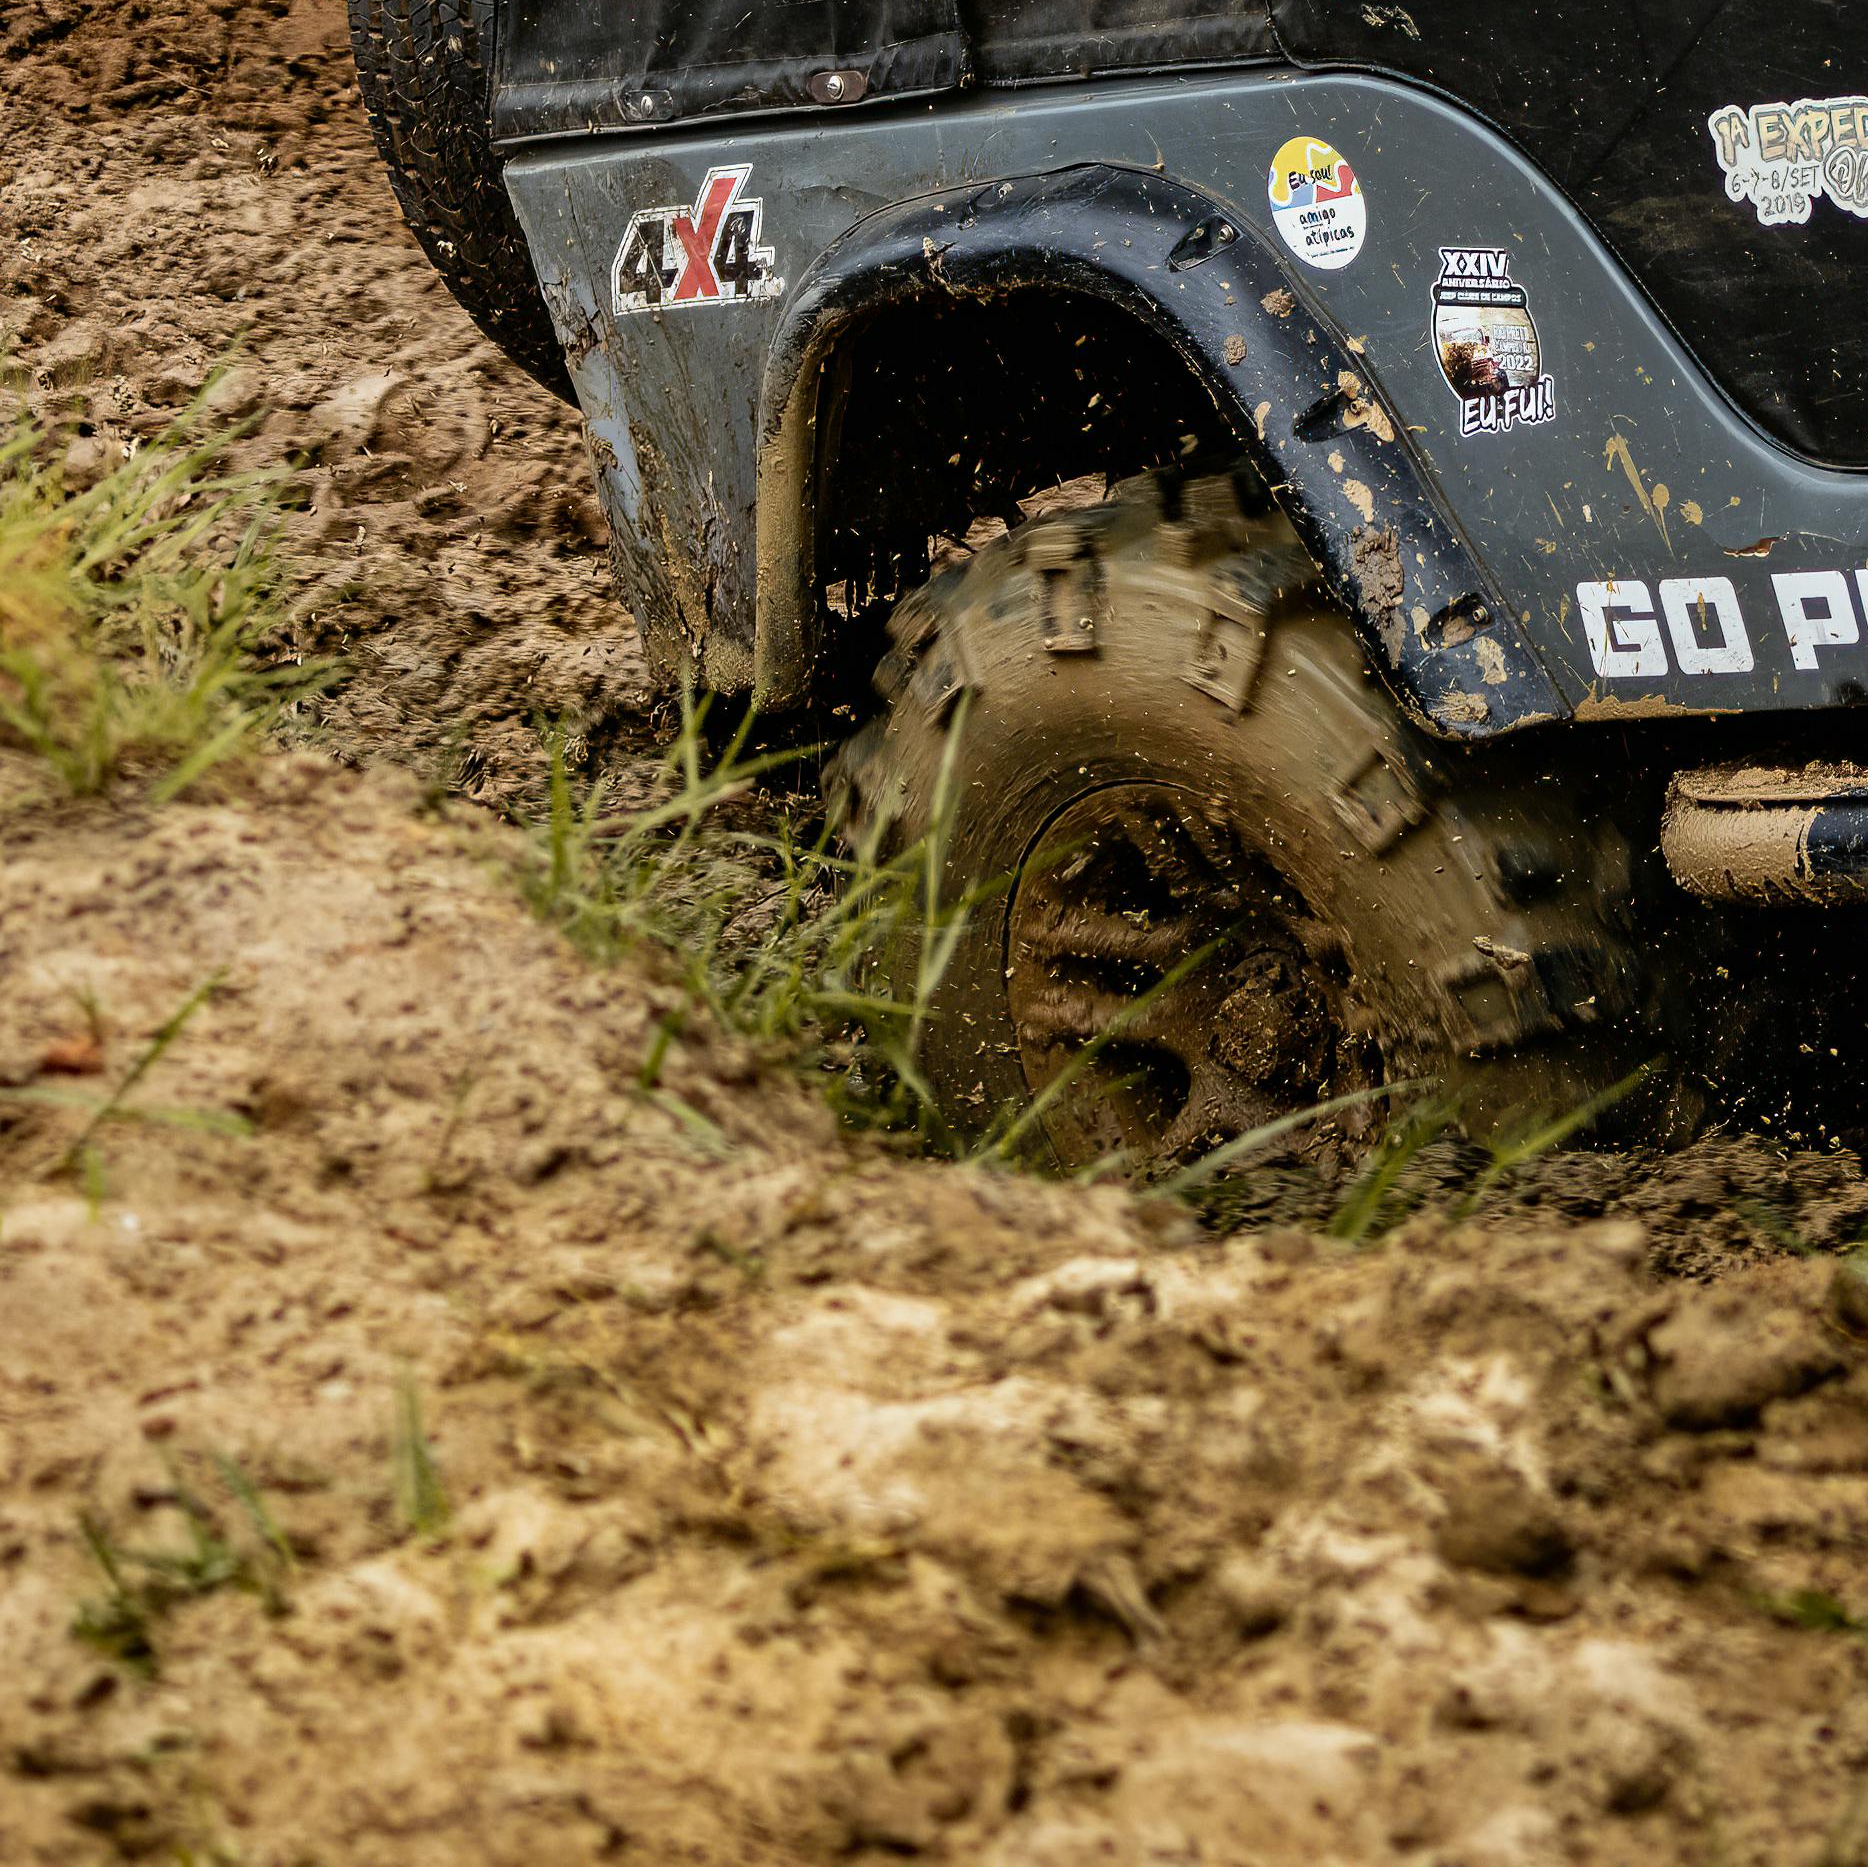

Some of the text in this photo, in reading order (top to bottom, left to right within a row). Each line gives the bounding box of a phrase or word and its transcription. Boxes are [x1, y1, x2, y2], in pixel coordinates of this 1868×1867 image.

[1288, 170, 1307, 191] Eu
[1299, 207, 1336, 225] amigo
[1305, 225, 1355, 247] atípicas
[1443, 251, 1507, 277] XXIV
[1499, 353, 1535, 372] 2022
[1463, 380, 1555, 433] EU FUI!
[1577, 576, 1755, 679] GO
